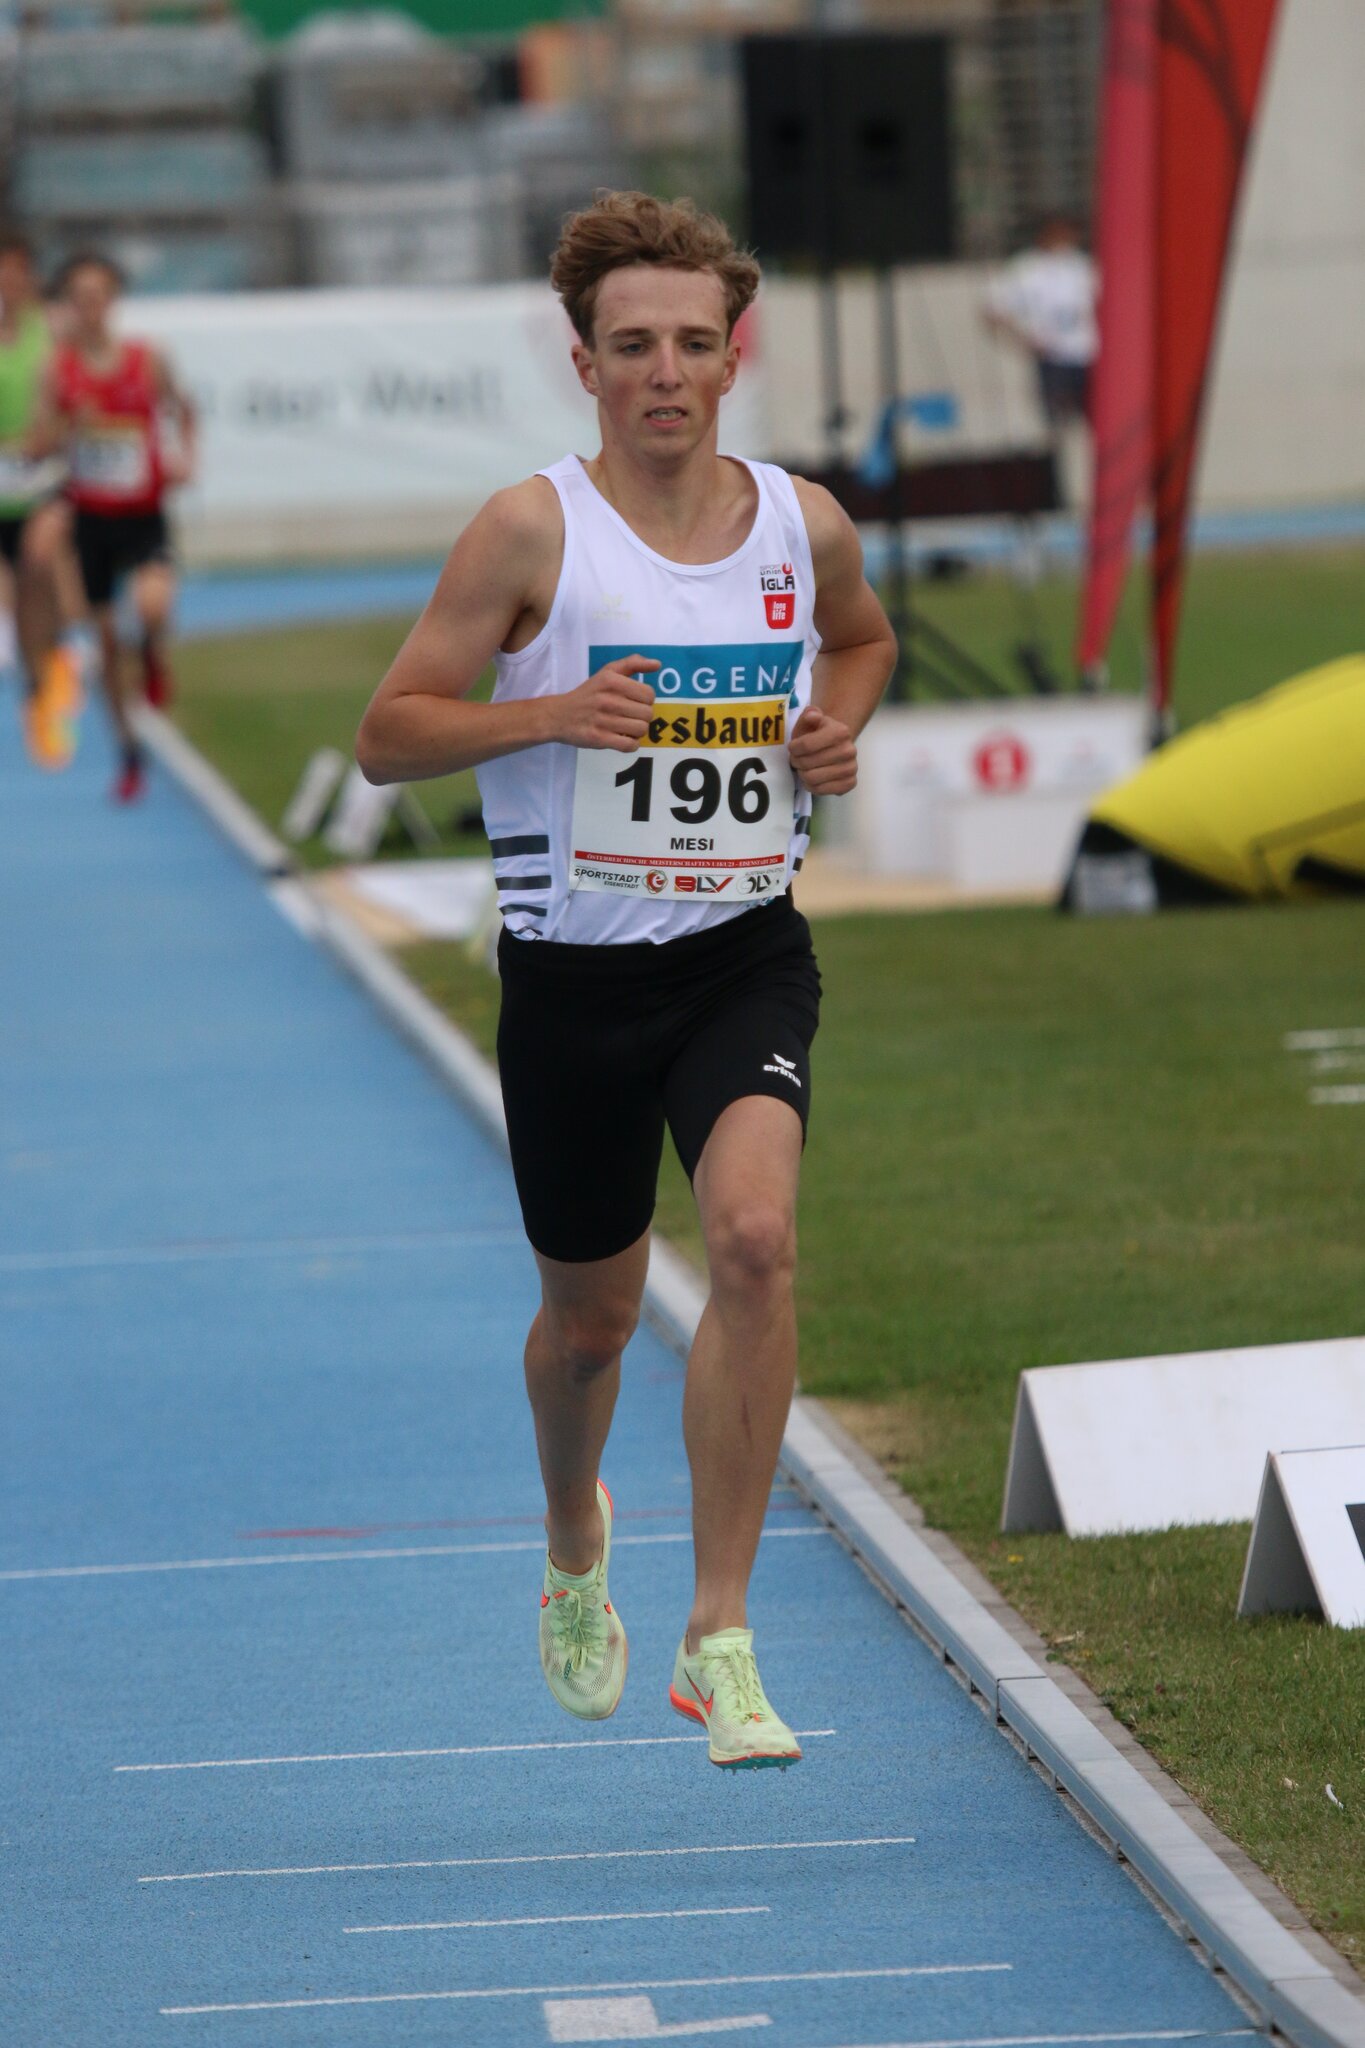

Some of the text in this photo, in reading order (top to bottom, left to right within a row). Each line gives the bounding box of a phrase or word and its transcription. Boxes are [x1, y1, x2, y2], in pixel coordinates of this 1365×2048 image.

[761, 575, 795, 591] IGLA
[648, 707, 784, 745] esbauer
[615, 756, 770, 824] 196
[670, 837, 714, 851] MESI
[574, 868, 641, 883] SPORTSTADT
[675, 875, 734, 893] BLV
[604, 881, 639, 889] EISENSTADT
[763, 1064, 802, 1088] erima
